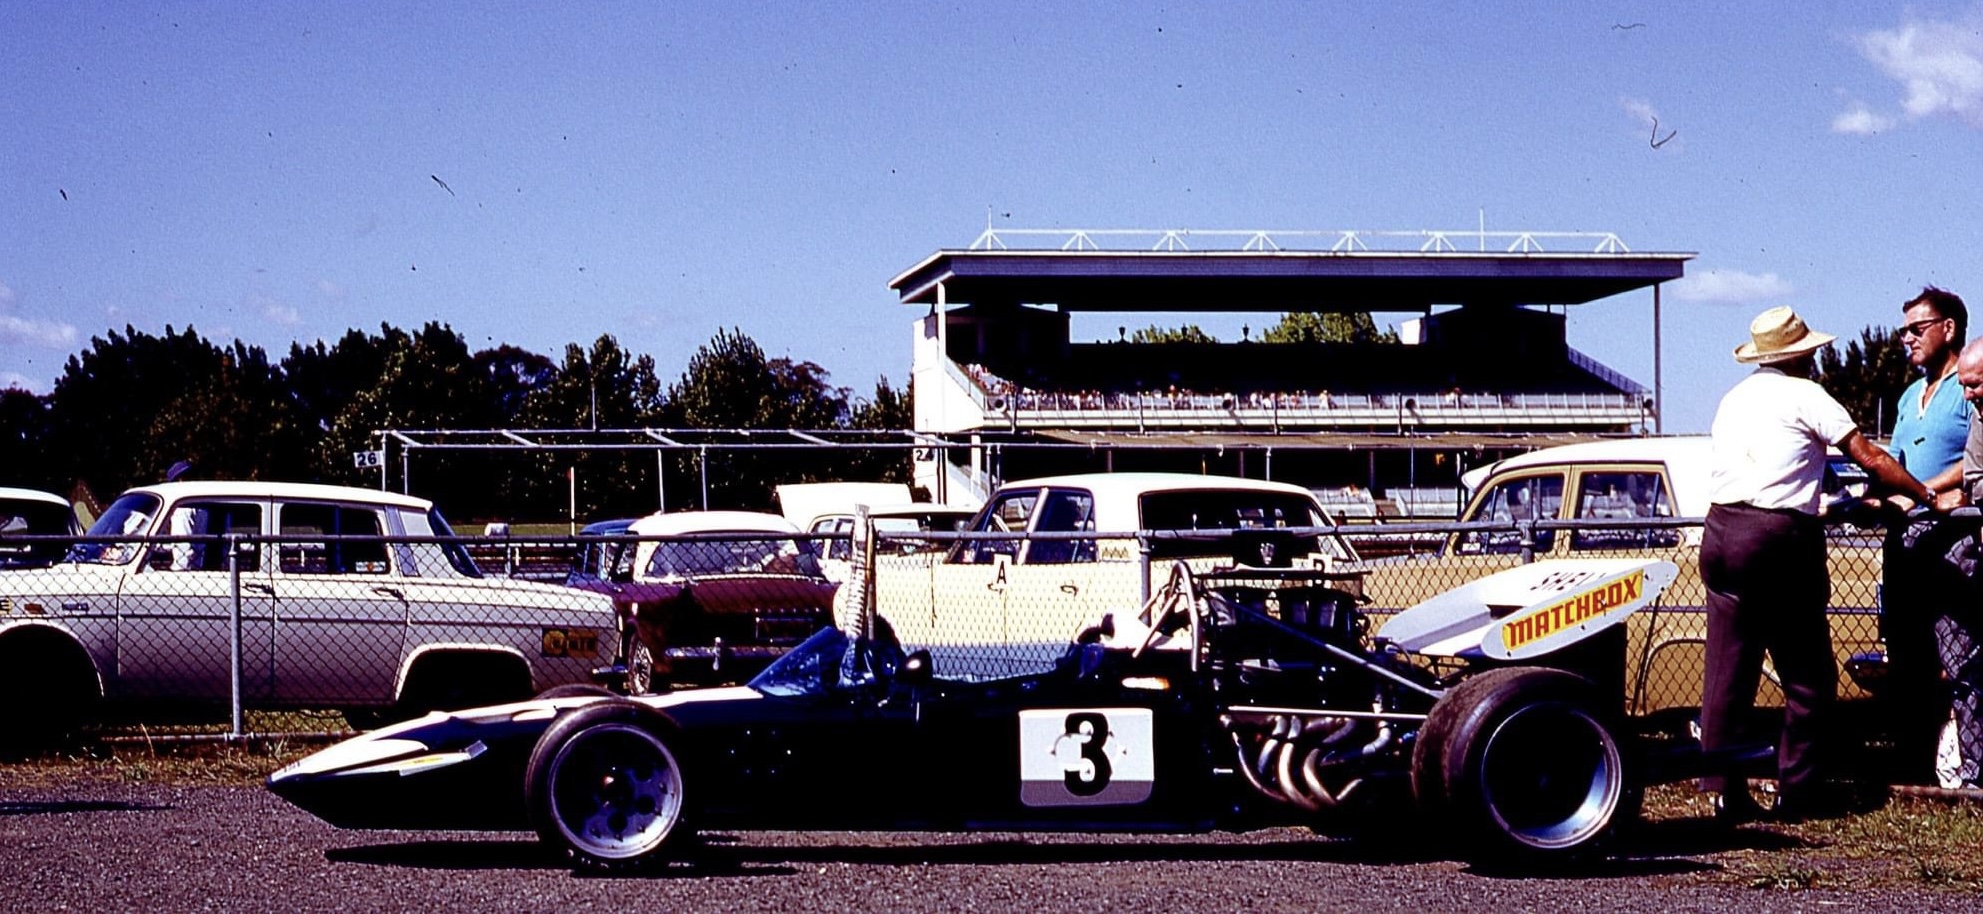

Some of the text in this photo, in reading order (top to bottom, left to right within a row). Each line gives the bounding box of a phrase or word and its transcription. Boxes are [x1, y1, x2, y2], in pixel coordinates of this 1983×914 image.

[357, 452, 377, 466] 26
[996, 560, 1007, 584] A
[1506, 573, 1639, 648] MATCHBOX
[1064, 712, 1113, 797] 3
